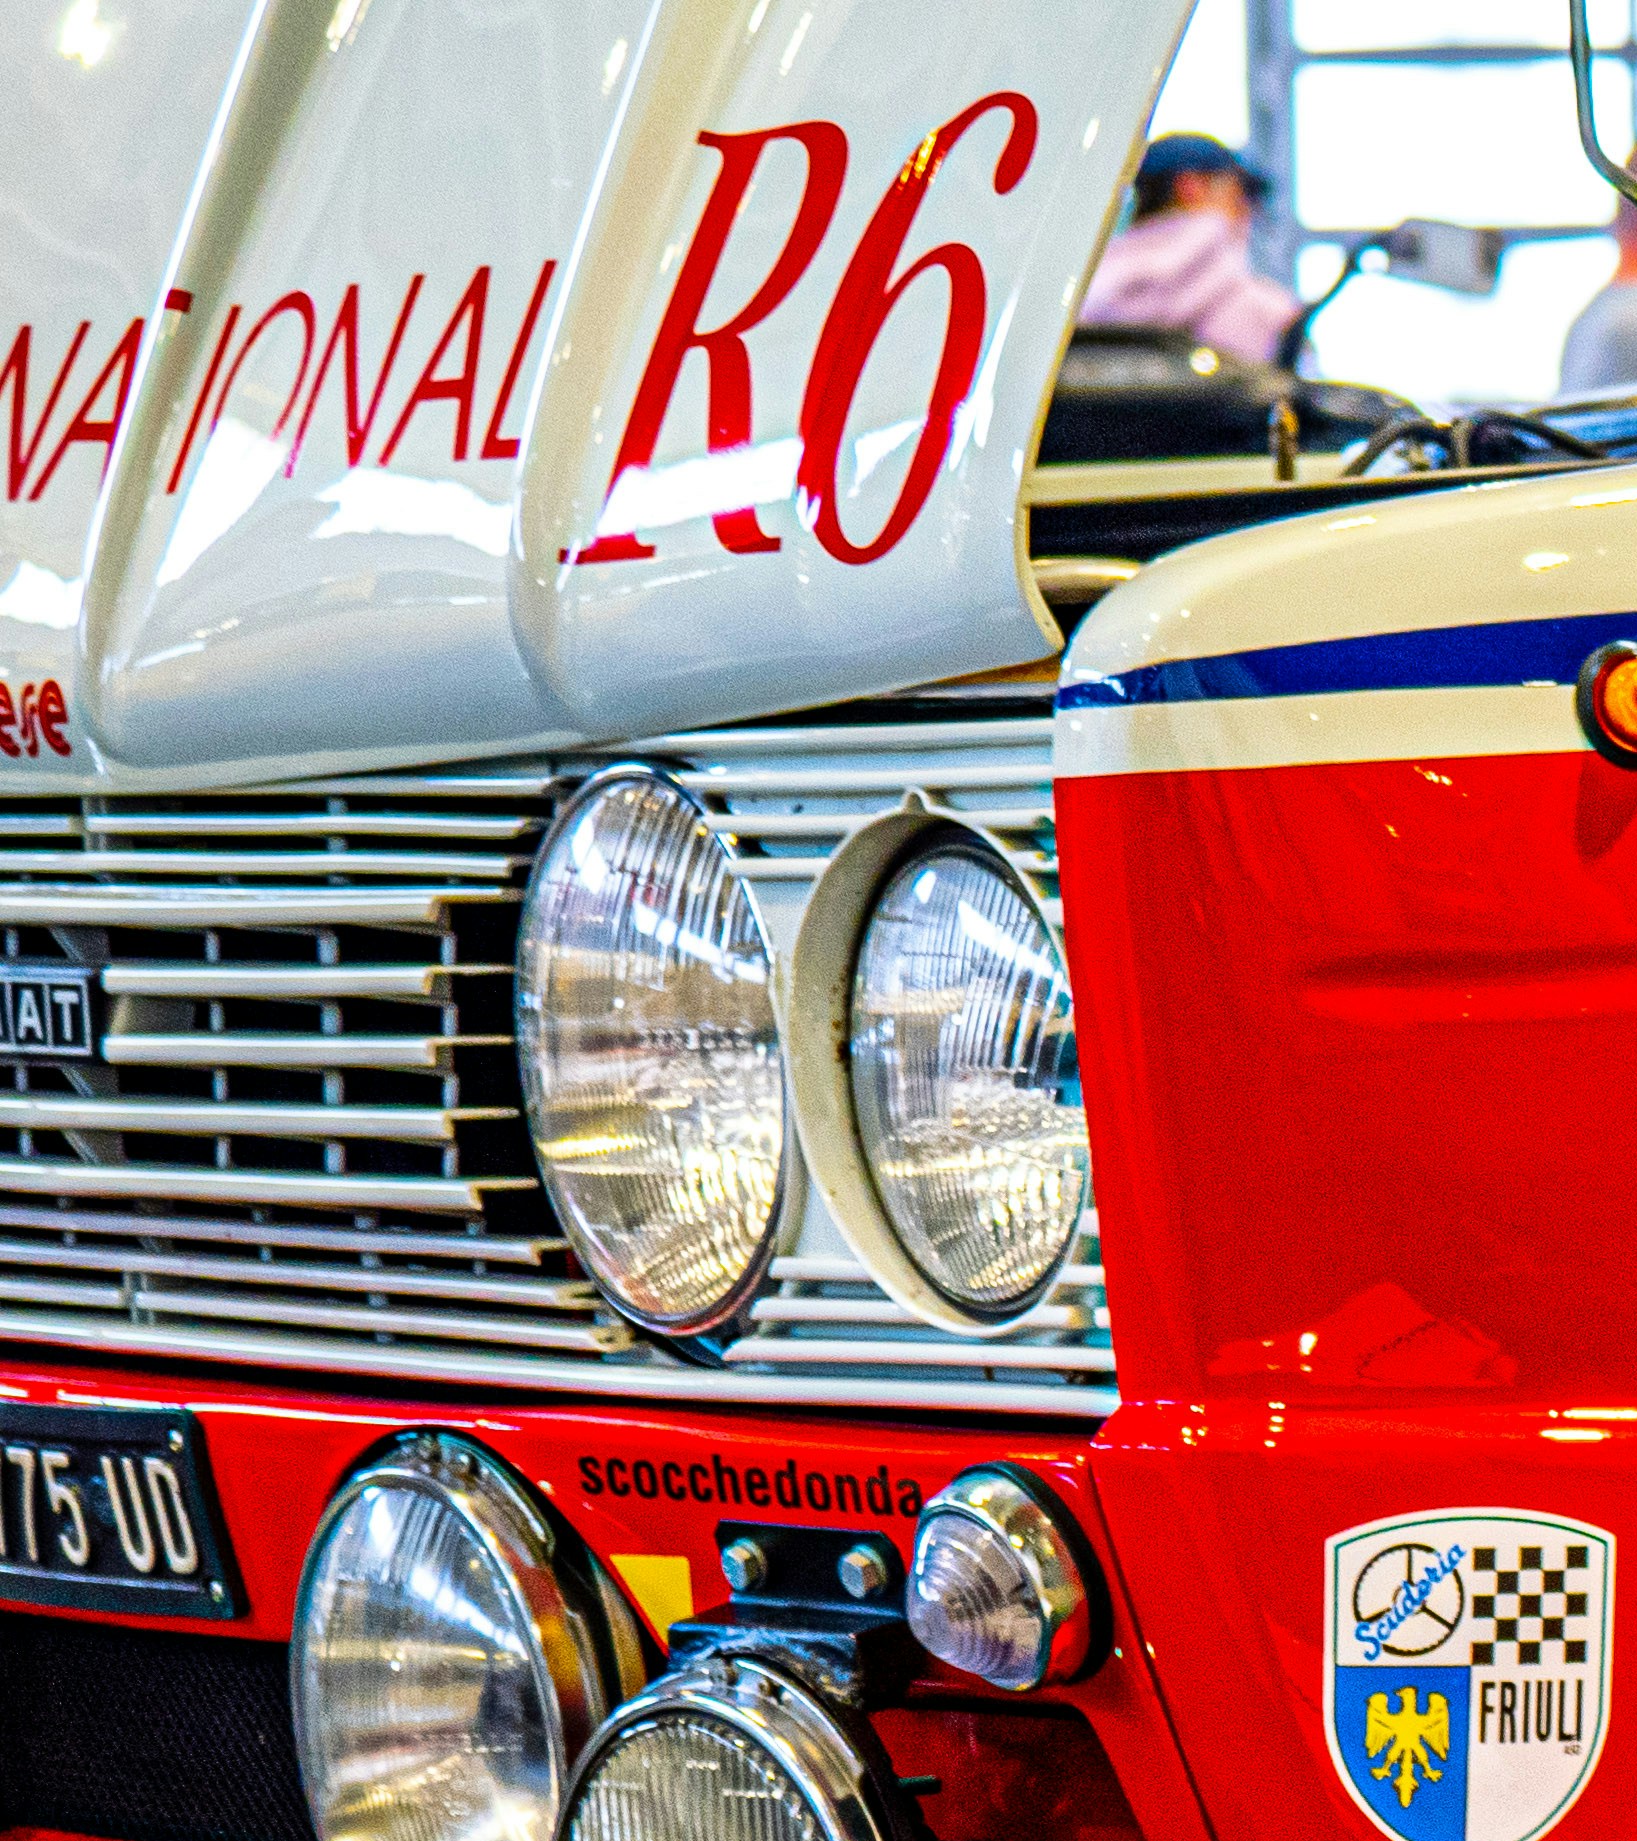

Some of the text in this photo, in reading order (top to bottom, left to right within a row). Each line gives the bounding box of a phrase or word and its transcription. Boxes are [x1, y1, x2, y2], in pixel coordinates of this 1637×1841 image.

[559, 91, 1038, 565] R6
[0, 988, 80, 1042] AT
[0, 1446, 198, 1575] 75 UD
[578, 1454, 923, 1518] scocchedonda
[1355, 1544, 1466, 1661] Scuderia
[1480, 1679, 1584, 1744] FRIULI
